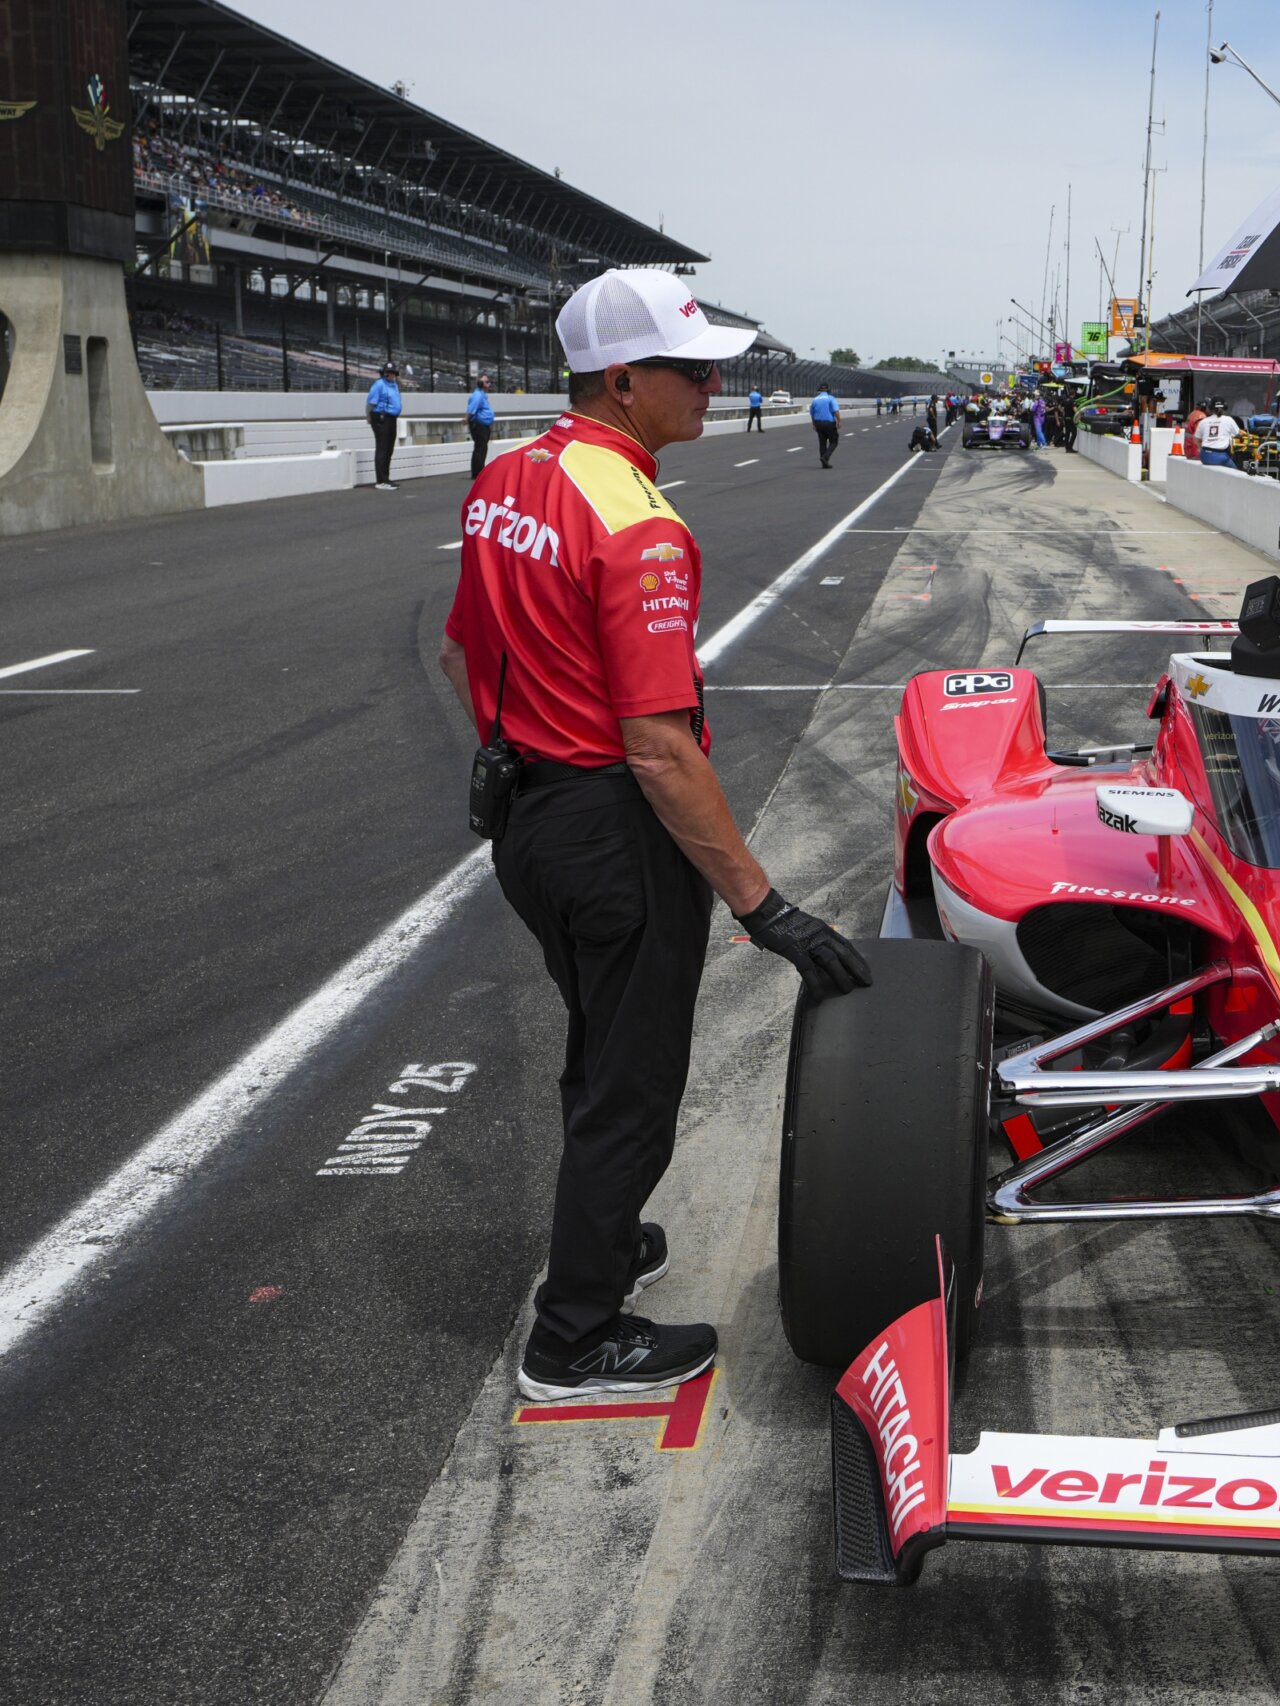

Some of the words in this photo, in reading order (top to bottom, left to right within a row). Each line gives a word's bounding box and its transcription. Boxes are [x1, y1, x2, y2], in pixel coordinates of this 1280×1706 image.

[1087, 331, 1101, 342] 76
[464, 495, 560, 568] erizon
[948, 674, 1010, 694] PPG
[940, 698, 1018, 711] Snap-on
[1203, 732, 1237, 741] verizon
[1108, 789, 1176, 798] SIEMENS
[1096, 800, 1139, 835] azak
[1050, 881, 1197, 906] Firestone
[315, 1103, 450, 1176] INDY
[862, 1341, 926, 1537] HITACHI
